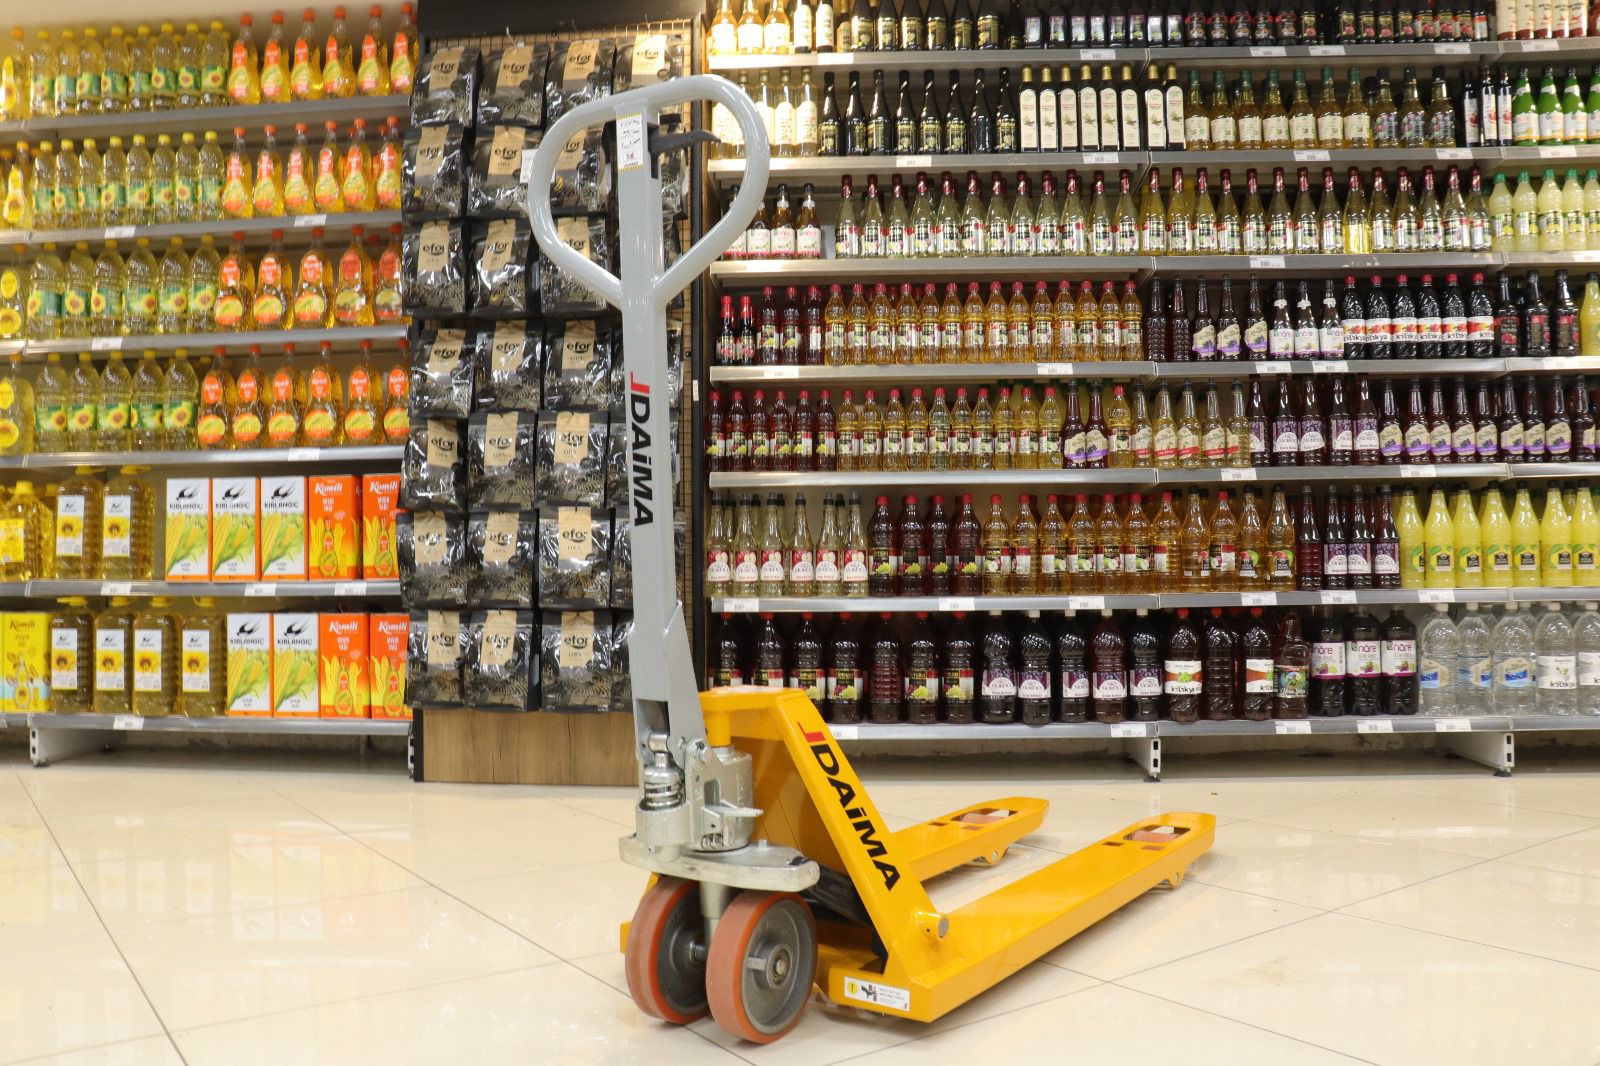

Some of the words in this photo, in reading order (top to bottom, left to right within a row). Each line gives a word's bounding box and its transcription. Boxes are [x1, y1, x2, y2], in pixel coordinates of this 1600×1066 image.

[568, 53, 592, 65] efor
[433, 61, 456, 74] efor
[502, 62, 526, 74] efor
[419, 146, 441, 159] efor
[494, 146, 518, 159] efor
[564, 139, 581, 153] for
[434, 348, 457, 359] efor
[566, 342, 592, 355] efor
[430, 436, 455, 451] efor
[560, 432, 584, 447] efor
[314, 482, 343, 496] Komili
[369, 480, 398, 495] Komili
[328, 620, 359, 635] Komili
[378, 620, 408, 635] Komili
[432, 632, 457, 647] efor
[563, 635, 590, 649] efor
